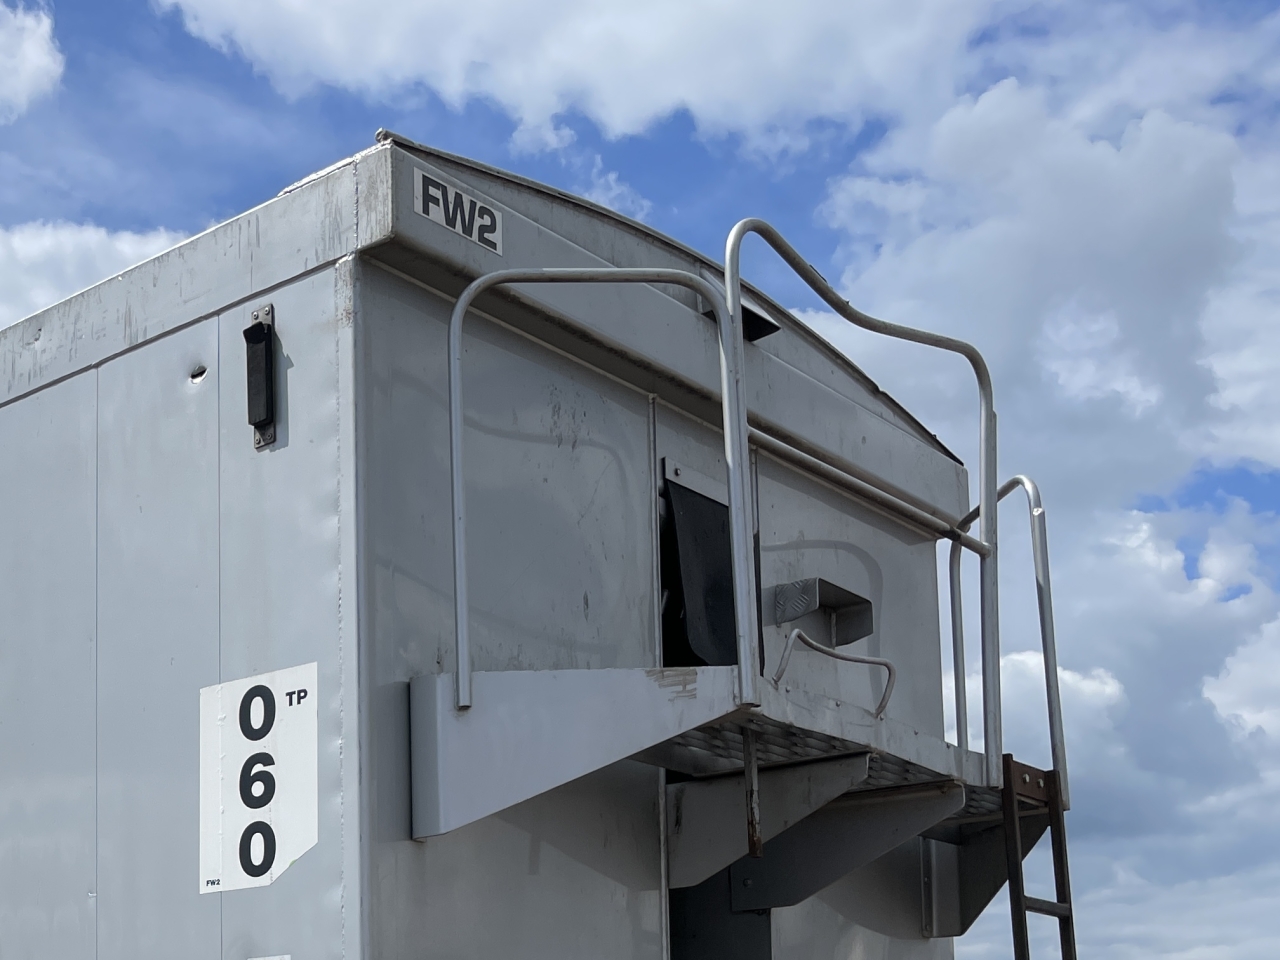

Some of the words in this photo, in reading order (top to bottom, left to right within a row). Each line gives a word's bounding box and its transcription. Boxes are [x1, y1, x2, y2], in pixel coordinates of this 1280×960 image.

[422, 173, 497, 252] FW2
[285, 688, 308, 707] TP
[206, 879, 221, 887] FW2
